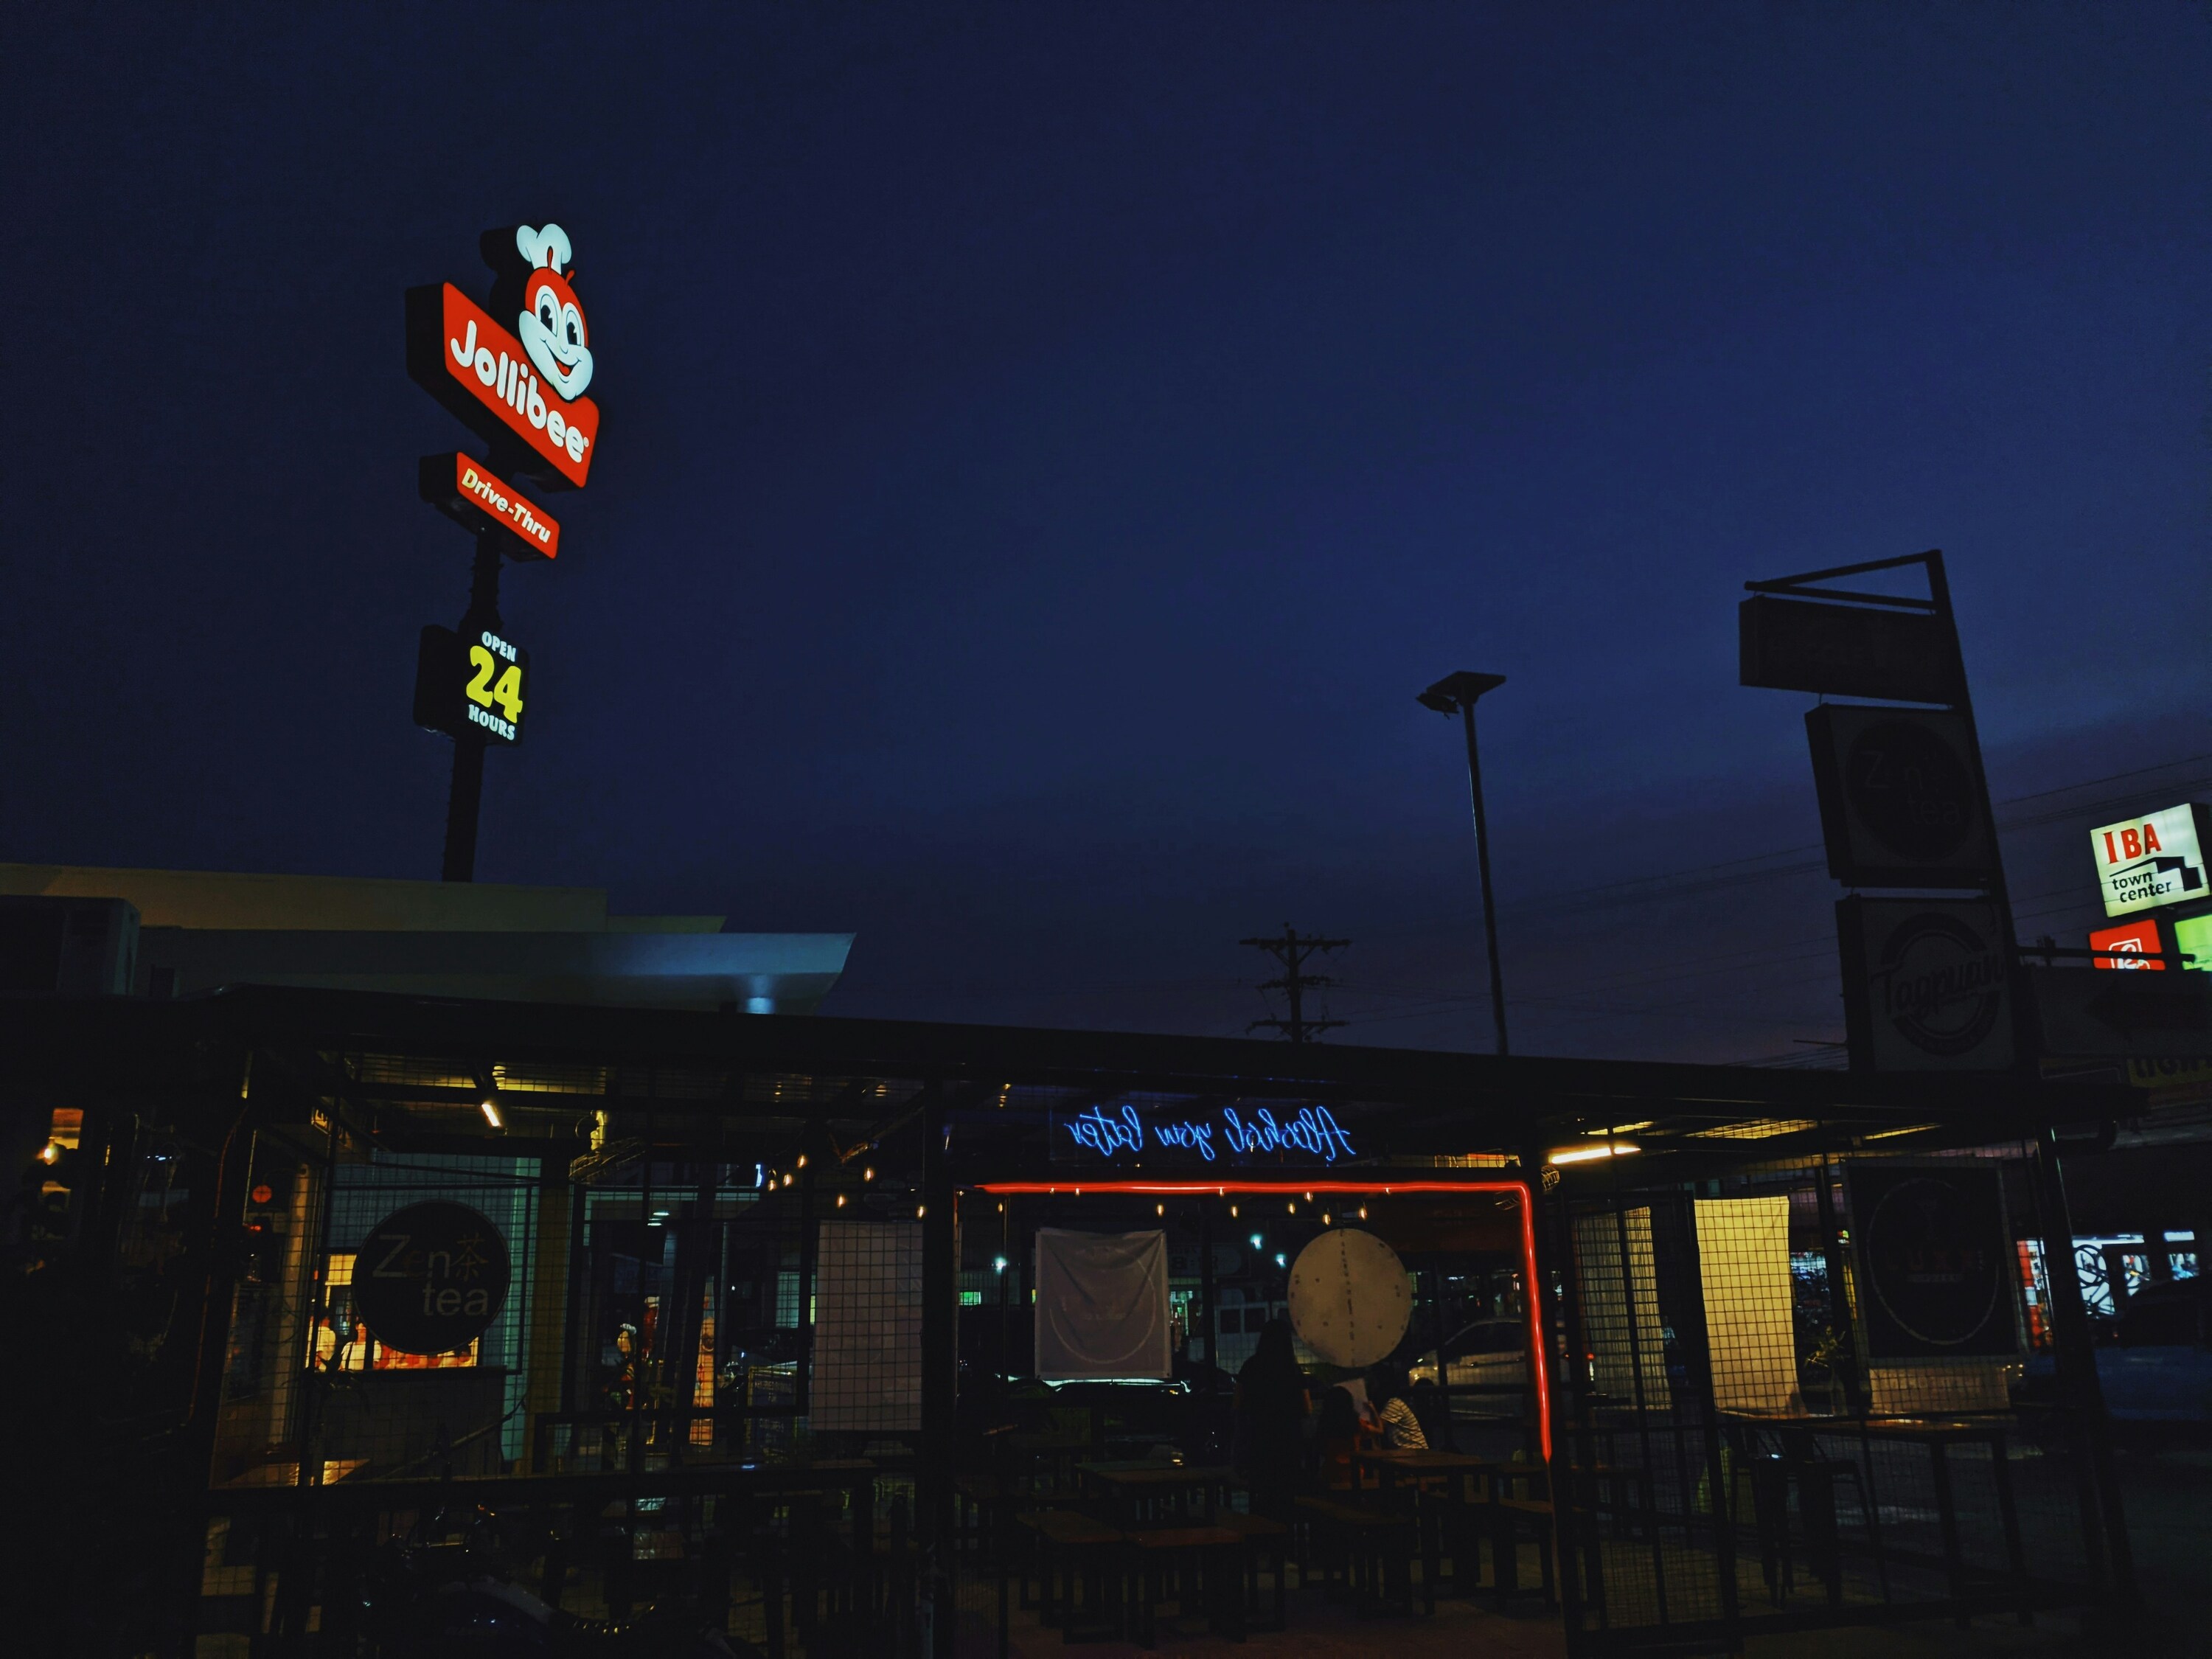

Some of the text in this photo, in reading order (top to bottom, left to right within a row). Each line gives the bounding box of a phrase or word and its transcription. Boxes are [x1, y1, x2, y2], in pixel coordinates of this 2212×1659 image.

[451, 320, 584, 462] Jollibee
[462, 468, 550, 543] Drive-Thru
[481, 631, 516, 662] OPEN
[466, 645, 523, 723] 24
[468, 704, 515, 740] HOURS
[2112, 872, 2152, 890] town
[2120, 882, 2172, 902] center
[422, 1280, 488, 1316] tea
